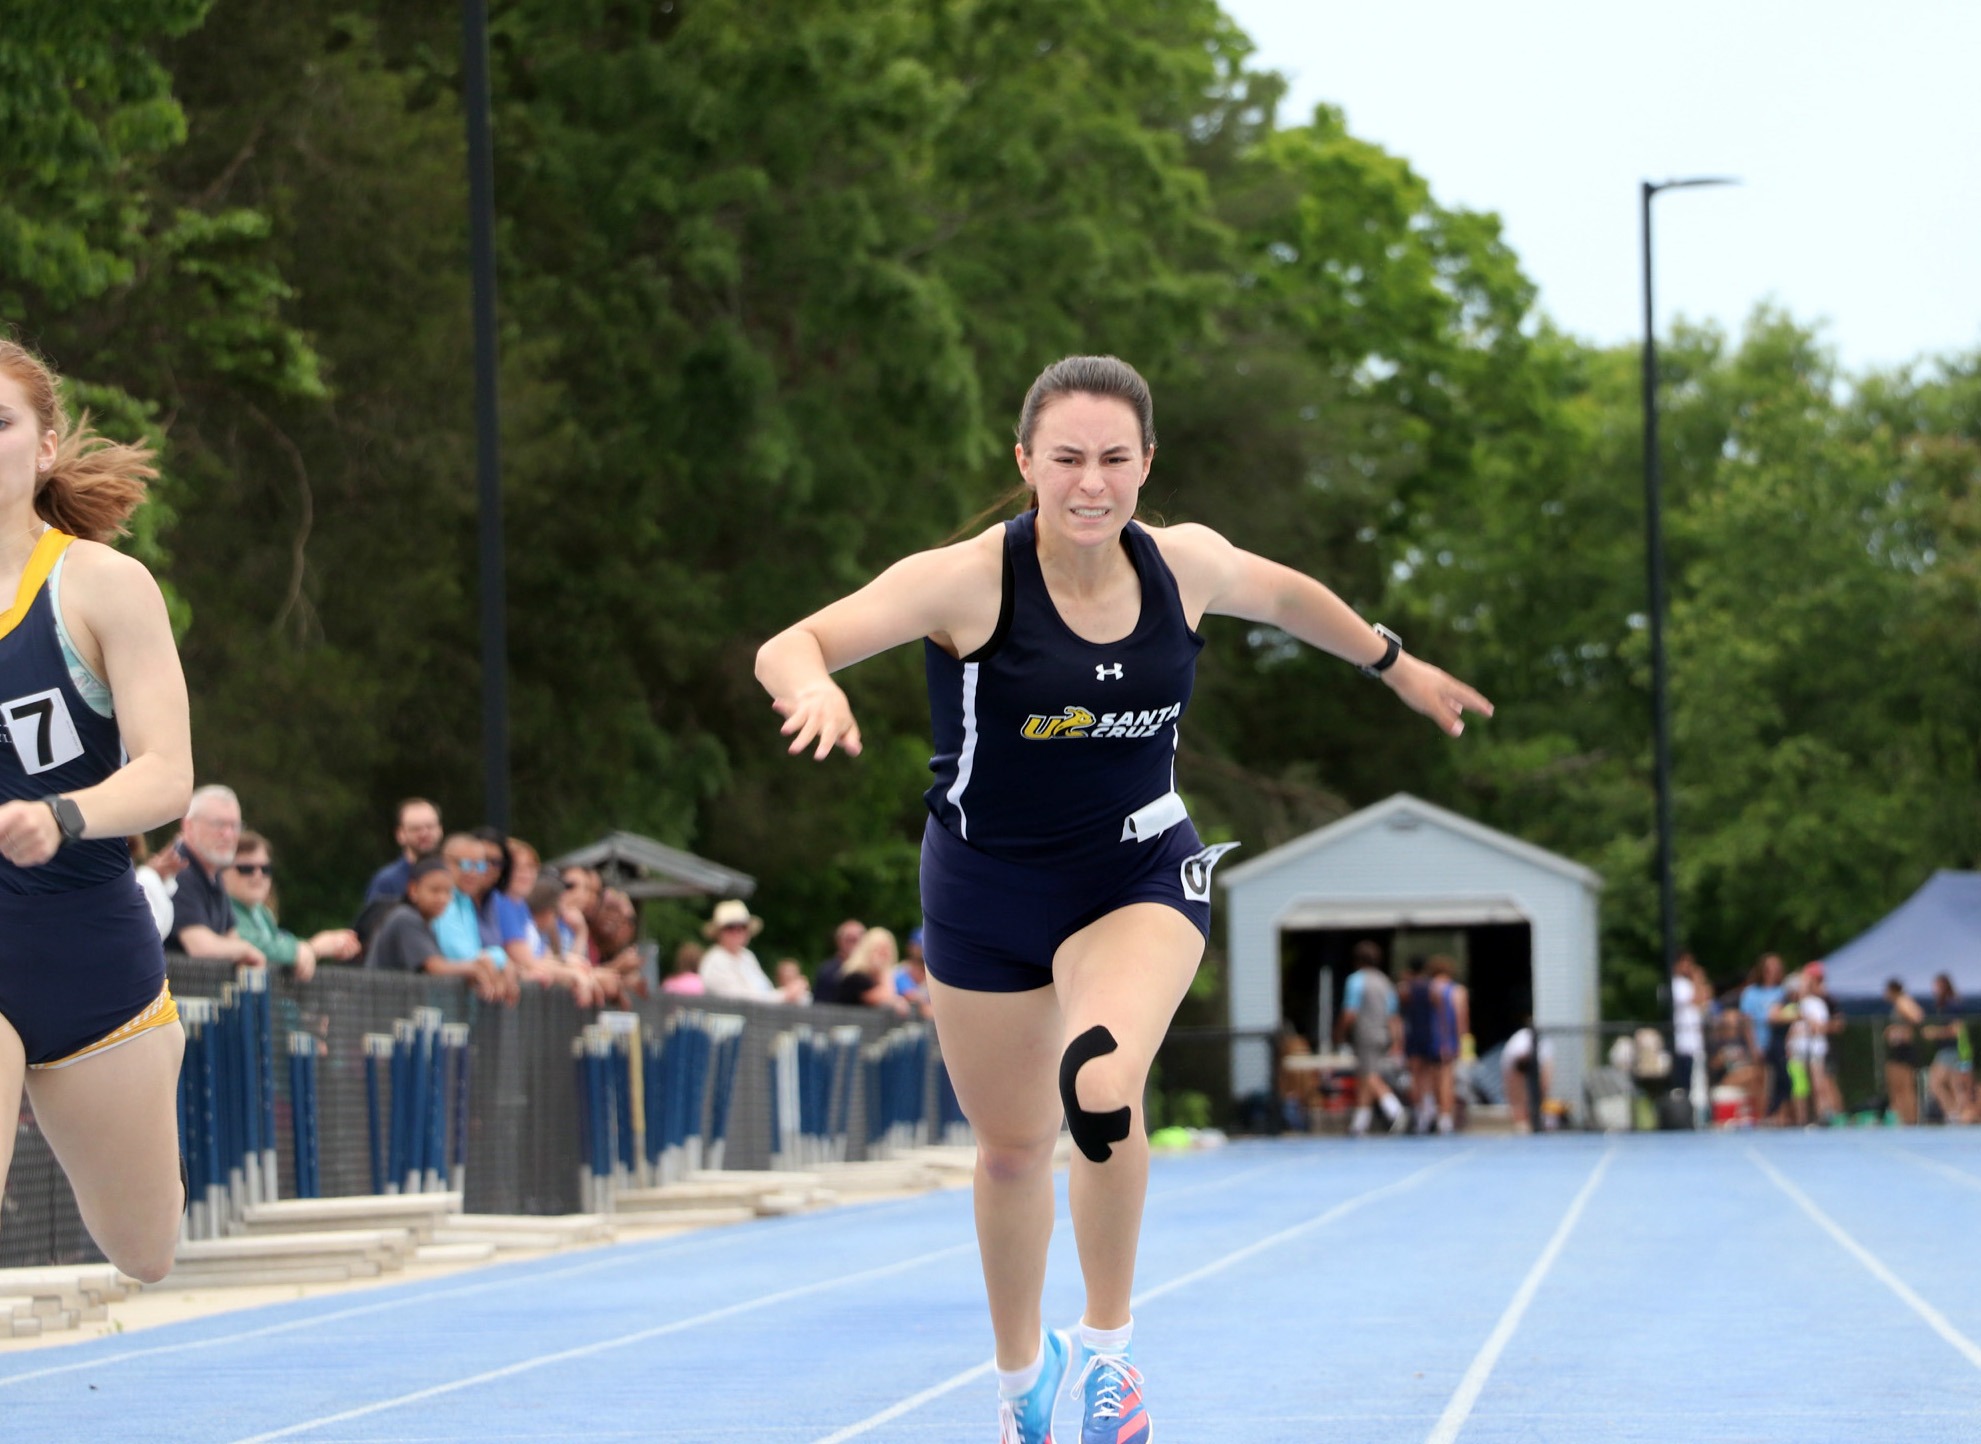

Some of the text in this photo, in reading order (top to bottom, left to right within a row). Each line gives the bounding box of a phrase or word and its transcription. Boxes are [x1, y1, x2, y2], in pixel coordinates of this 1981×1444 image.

[1099, 701, 1181, 727] SANTA
[10, 697, 54, 767] 7
[1091, 723, 1163, 738] CRUZ
